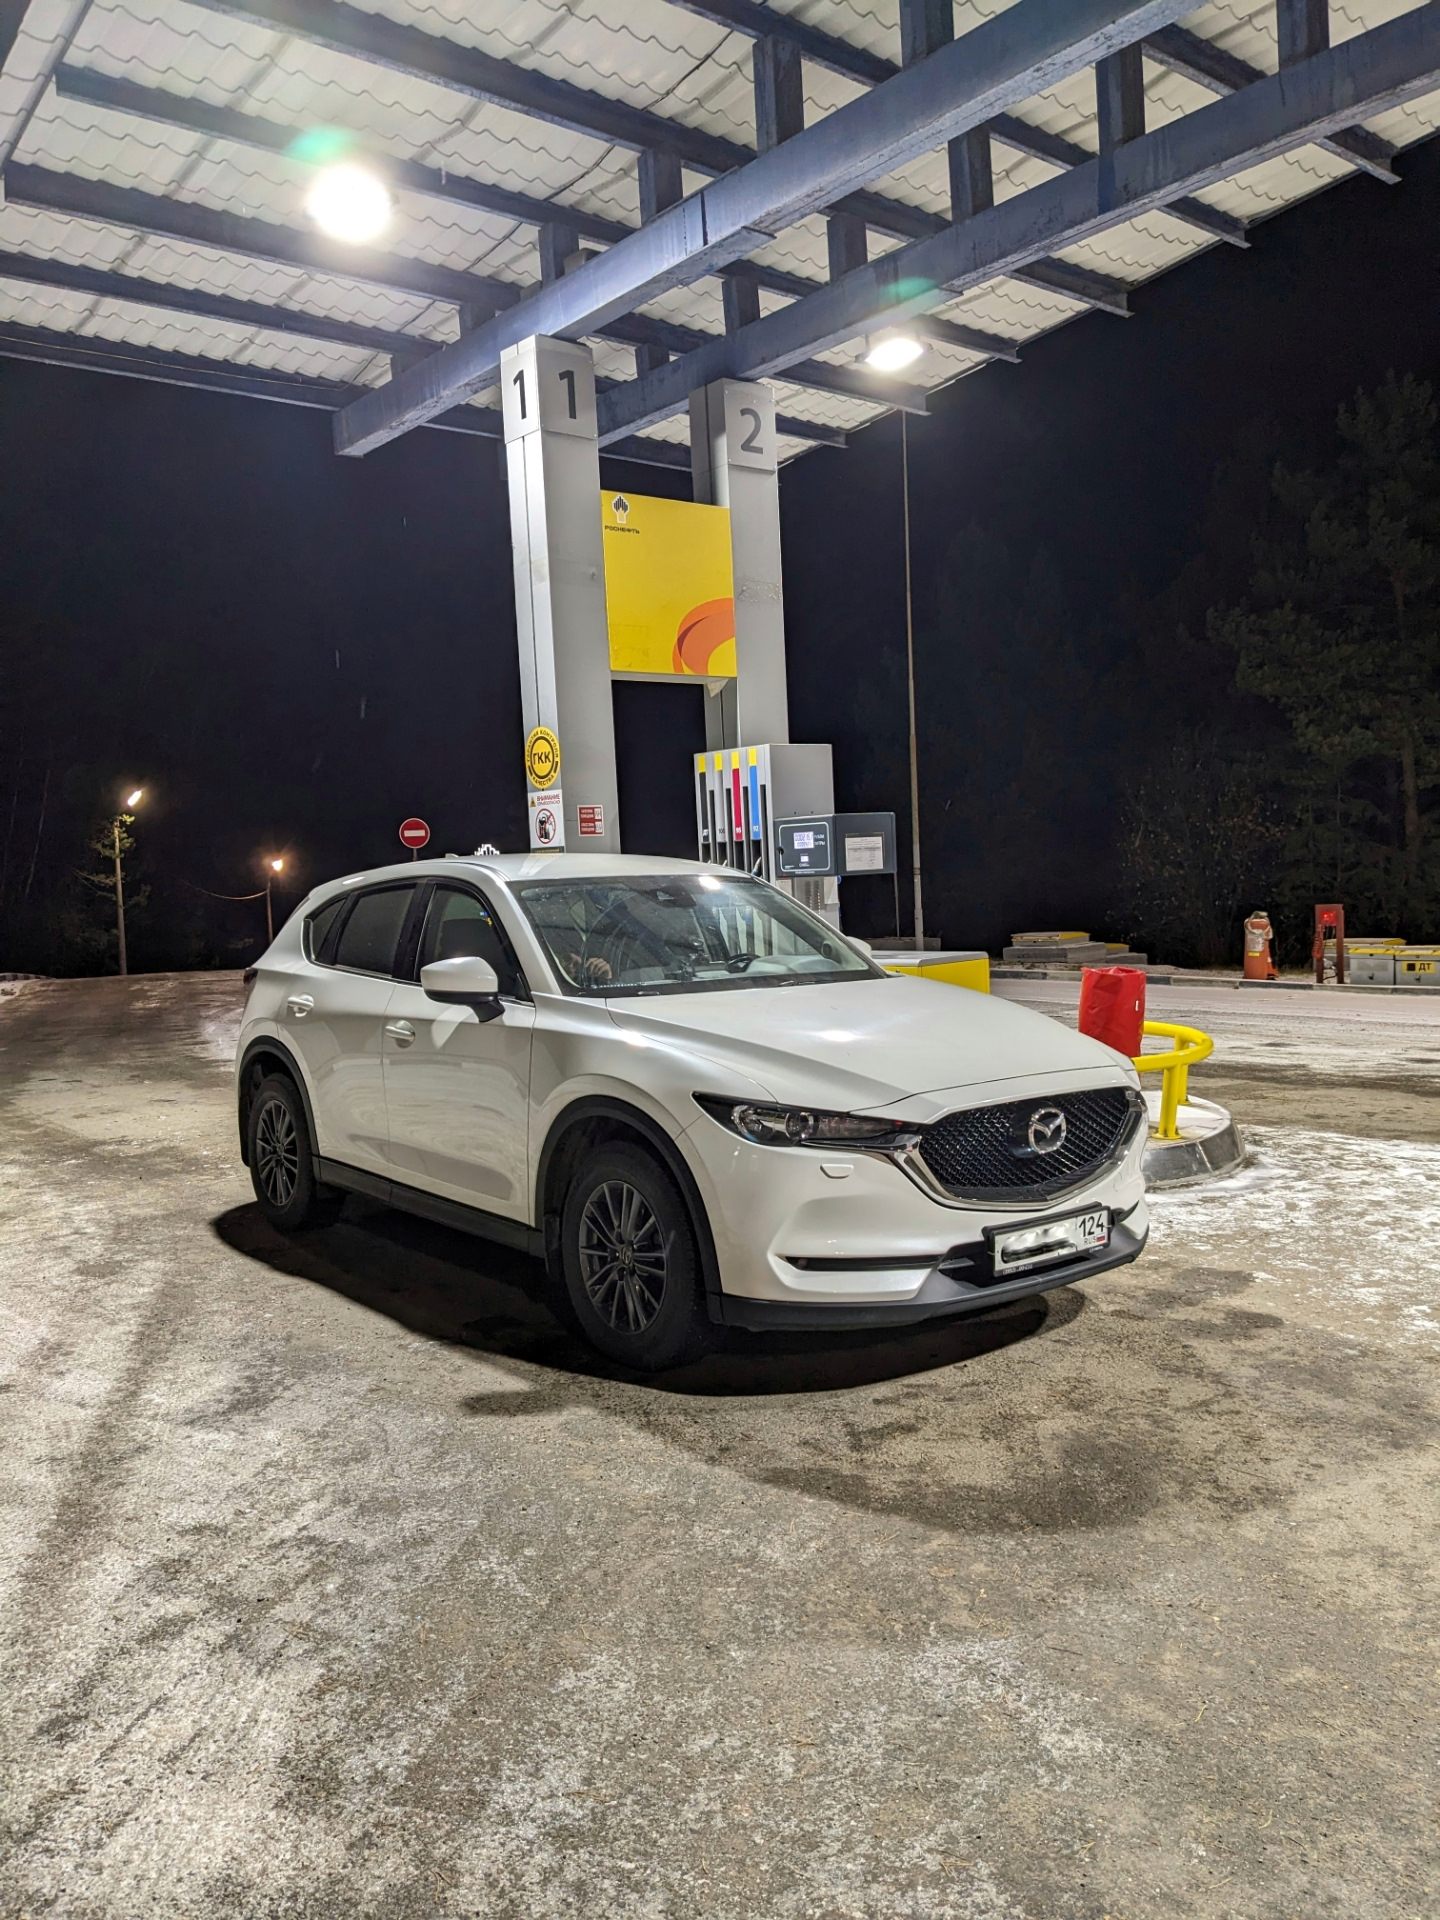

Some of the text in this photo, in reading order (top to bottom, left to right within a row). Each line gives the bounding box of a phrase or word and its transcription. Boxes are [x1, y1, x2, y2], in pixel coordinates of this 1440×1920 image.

[513, 369, 527, 420] 1
[558, 369, 577, 420] 1
[739, 407, 764, 455] 2
[604, 524, 640, 535] РОСНЕФТЬ
[533, 751, 551, 765] ГКК
[1418, 962, 1432, 972] ДТ
[1079, 1213, 1104, 1237] 124
[1084, 1237, 1097, 1246] RUS
